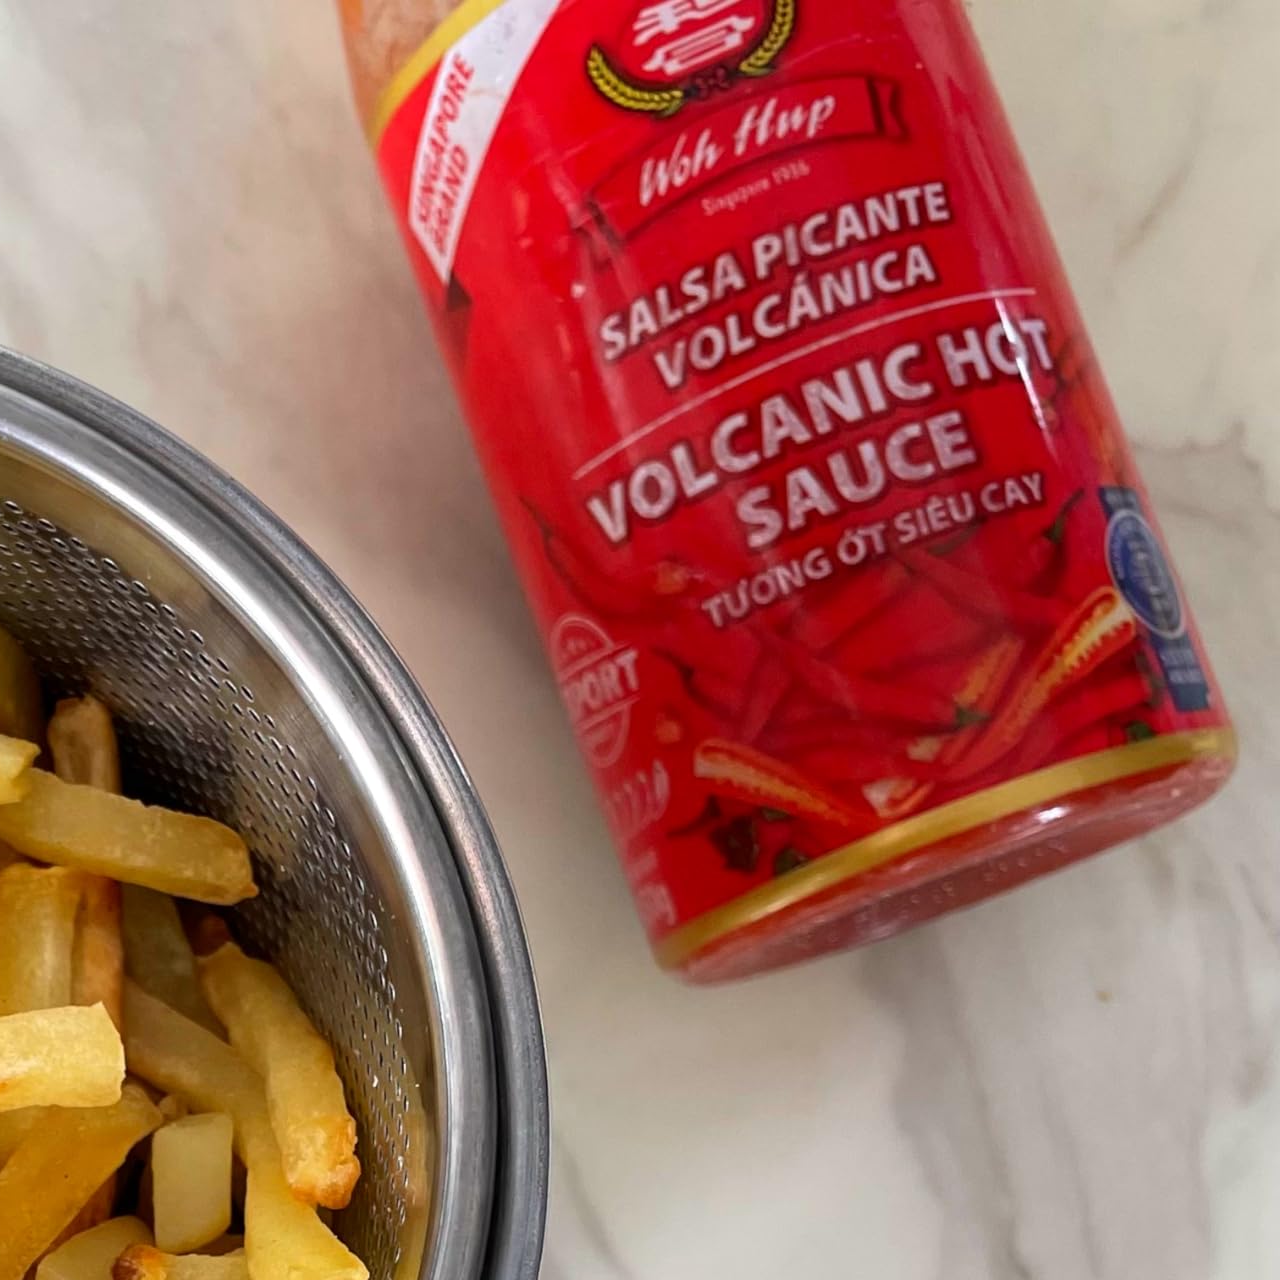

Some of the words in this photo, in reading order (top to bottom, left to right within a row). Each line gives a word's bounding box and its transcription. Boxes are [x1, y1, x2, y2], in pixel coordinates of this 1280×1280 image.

[639, 128, 723, 206] Woh
[733, 95, 835, 156] Hup
[599, 252, 746, 361] SALSA
[752, 181, 951, 280] PICANTE
[654, 243, 937, 388] VOLCÁNICA
[587, 342, 934, 544] VOLCANIC
[936, 318, 1054, 388] HOT
[735, 410, 977, 549] SAUCE
[894, 492, 975, 544] SIÊU
[980, 472, 1043, 513] CAY
